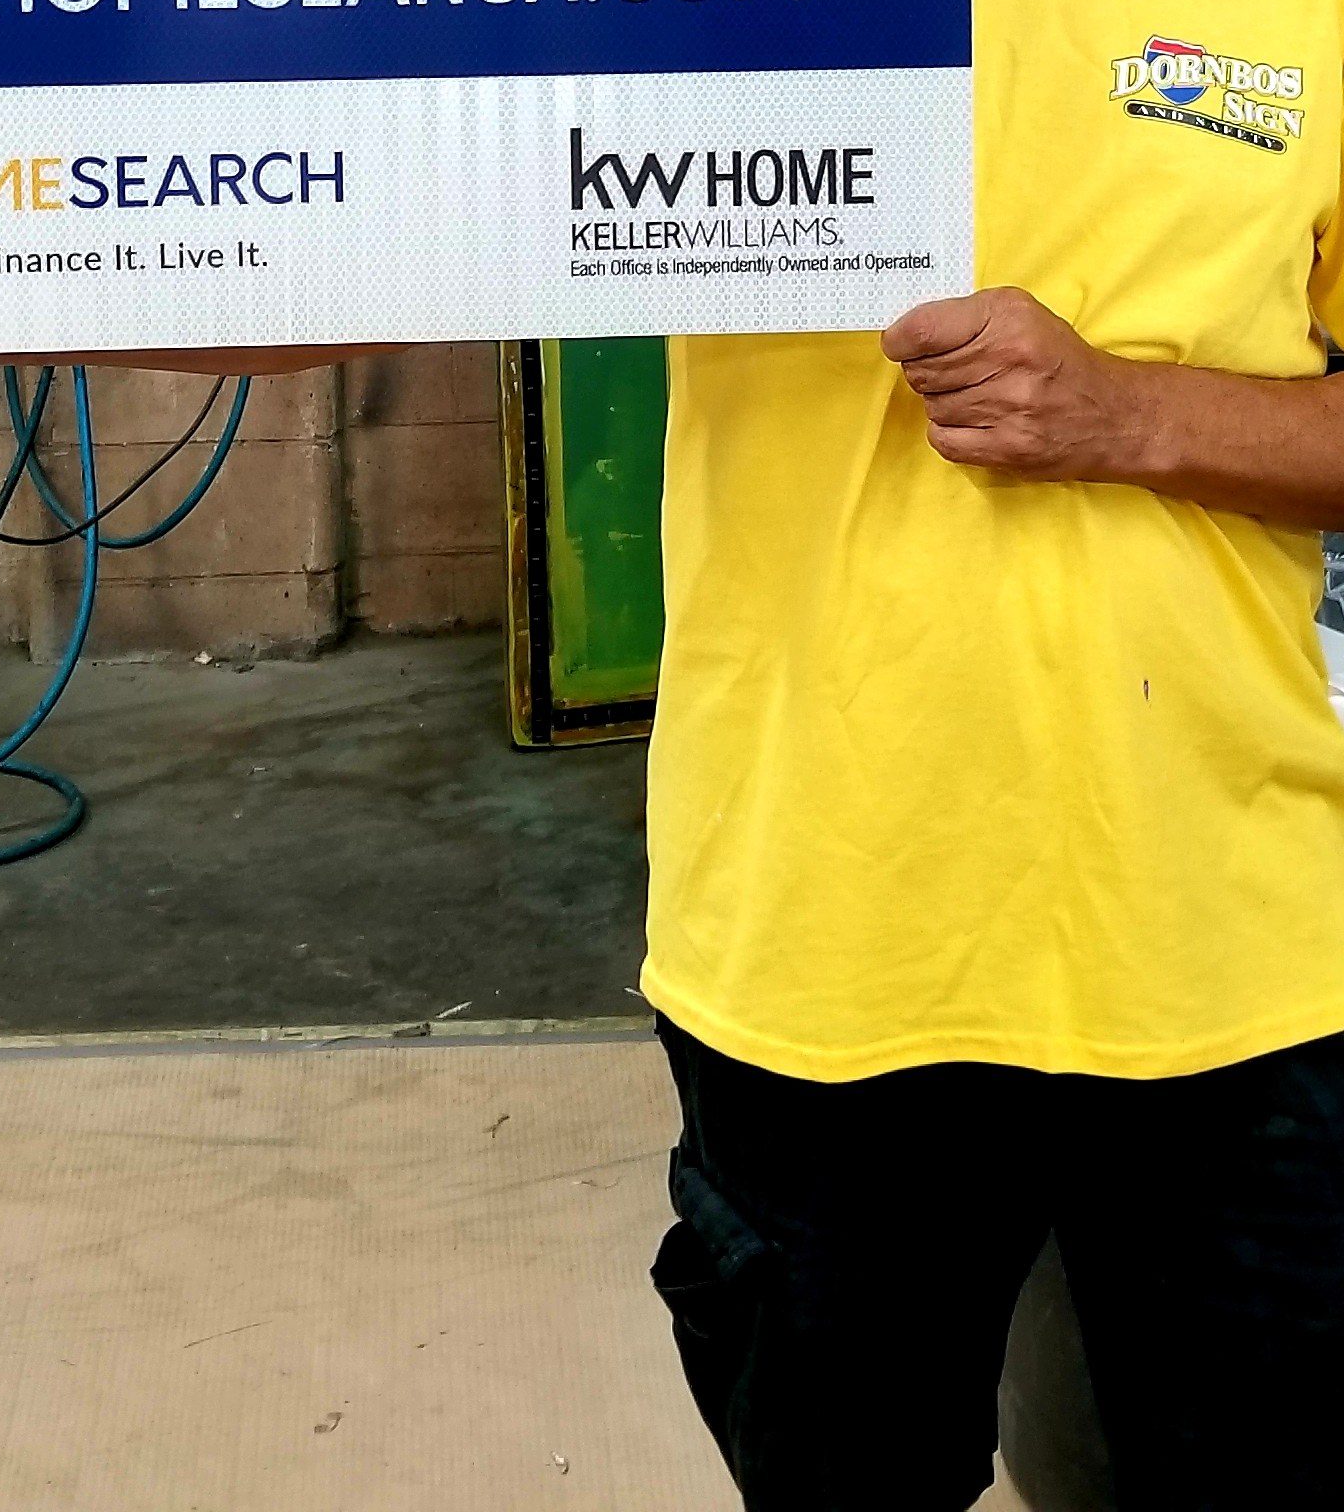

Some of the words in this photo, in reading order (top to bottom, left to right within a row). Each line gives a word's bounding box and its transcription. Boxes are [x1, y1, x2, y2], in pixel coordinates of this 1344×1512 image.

[1110, 54, 1303, 101] DORNBOS
[1136, 104, 1184, 121] AND
[1195, 116, 1275, 149] SAFETY
[1222, 90, 1305, 138] SIGN
[570, 127, 695, 211] kw
[706, 147, 875, 207] HOME
[116, 244, 146, 271] It.
[159, 242, 224, 269] Live
[237, 241, 268, 267] It.
[571, 260, 606, 277] Each
[611, 258, 652, 276] Office
[672, 257, 773, 277] Independently
[778, 255, 829, 273] Owned
[833, 255, 861, 272] and
[865, 254, 934, 273] Operated.
